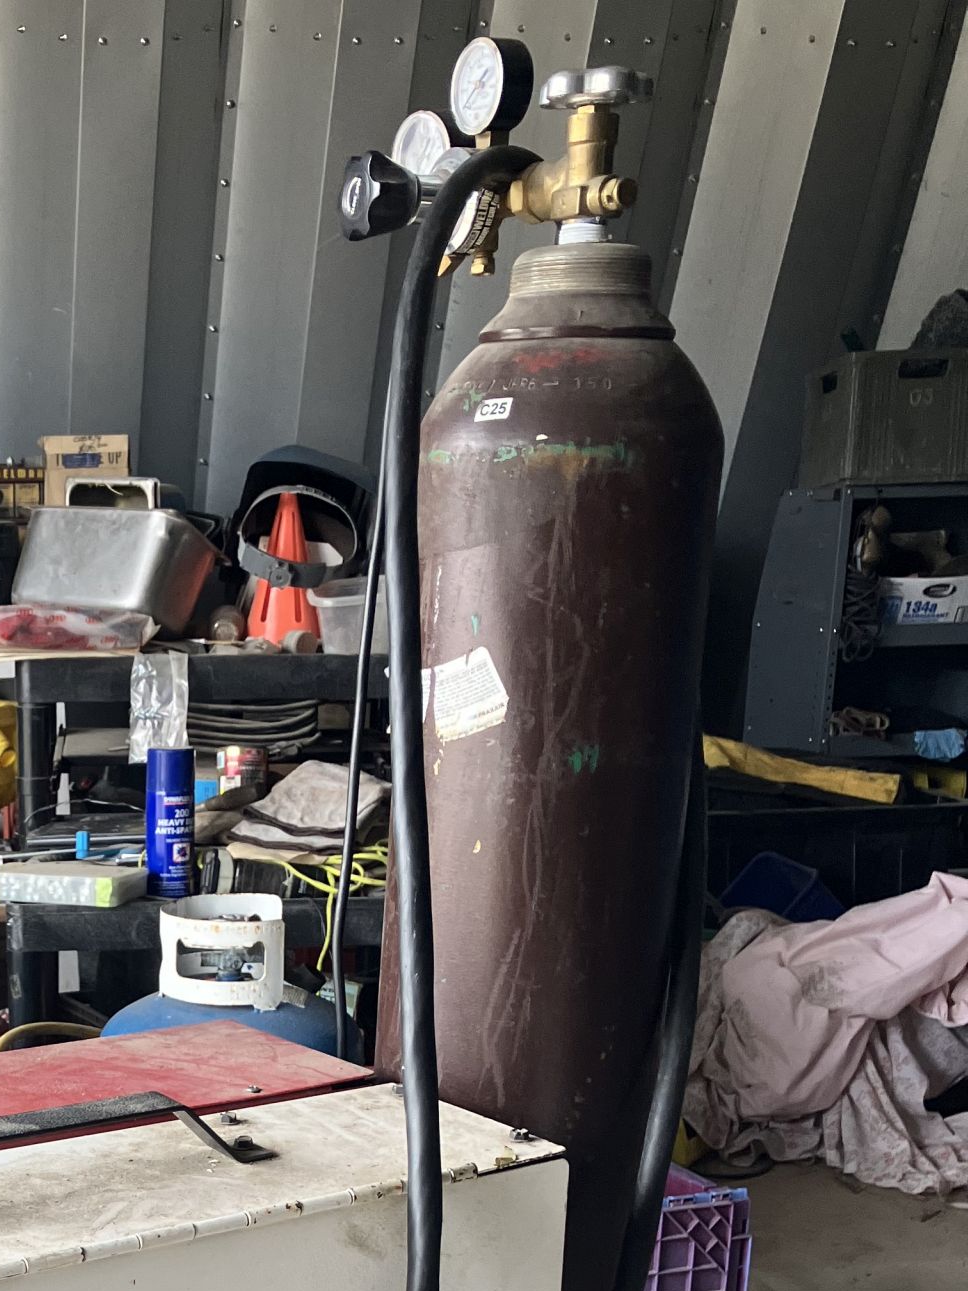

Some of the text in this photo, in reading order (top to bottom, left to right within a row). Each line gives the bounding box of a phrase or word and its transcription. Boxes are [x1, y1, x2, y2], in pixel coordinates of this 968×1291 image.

[479, 401, 509, 416] C25
[174, 808, 190, 818] 200
[157, 818, 185, 827] HEAVY
